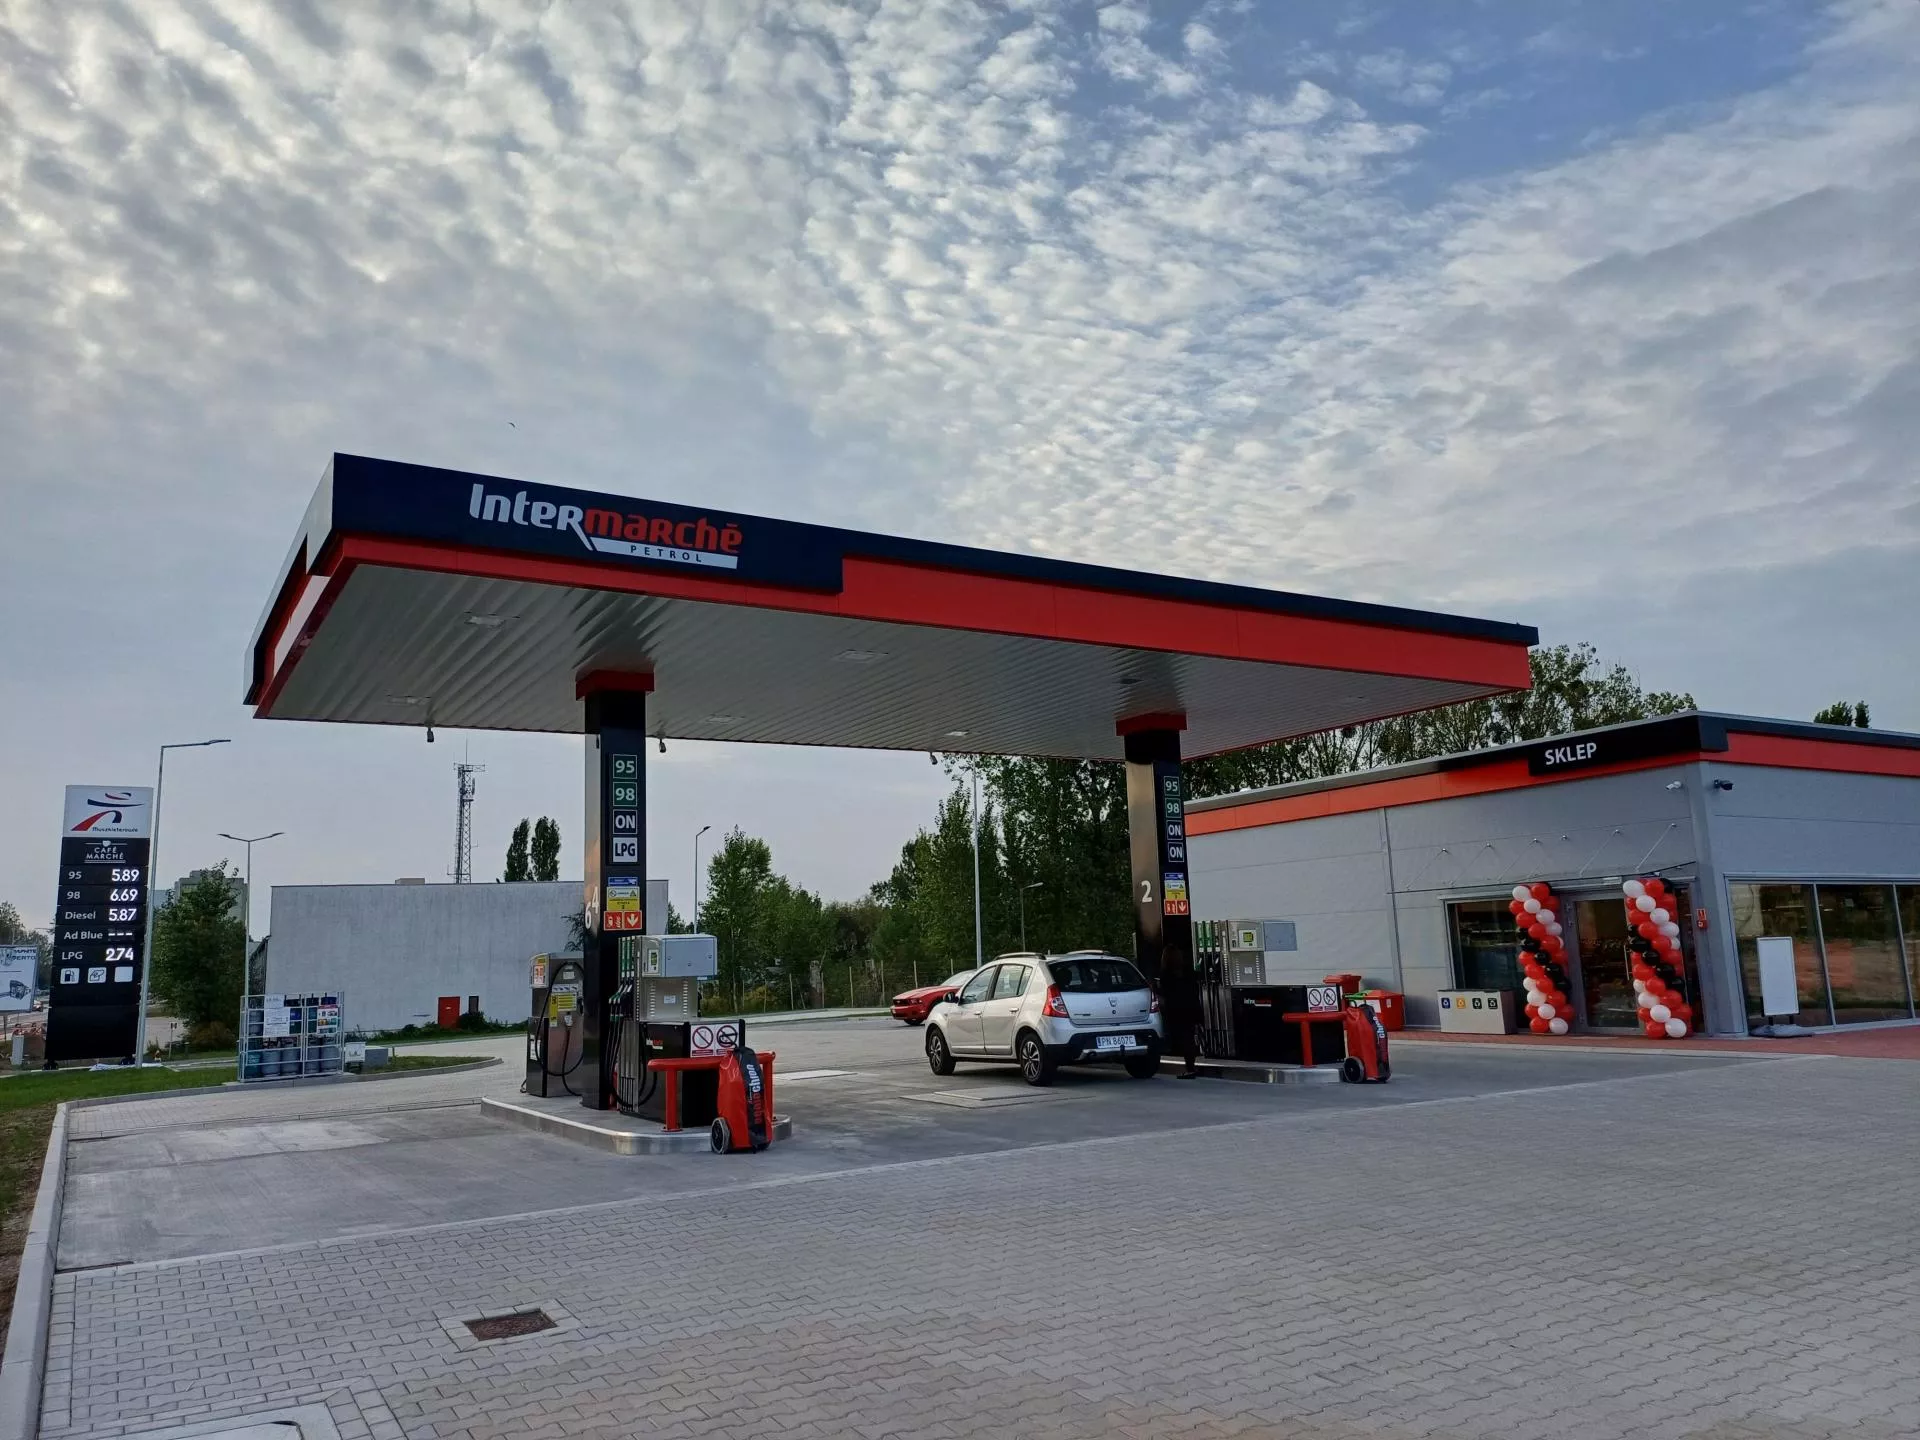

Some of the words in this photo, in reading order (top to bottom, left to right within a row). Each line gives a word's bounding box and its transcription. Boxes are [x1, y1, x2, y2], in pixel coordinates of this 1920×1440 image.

[631, 545, 702, 563] PETROL
[1545, 742, 1597, 765] SKLEP
[615, 760, 635, 774] 95
[1165, 781, 1178, 792] 95
[615, 788, 635, 801] 98
[1167, 803, 1180, 813] 98
[615, 815, 636, 829] ON
[1168, 825, 1181, 836] ON
[615, 843, 636, 857] LPG
[1169, 847, 1183, 858] ON
[68, 871, 82, 879] 95
[111, 869, 140, 881] 5.89
[66, 891, 81, 899] 98
[110, 889, 138, 901] 6.69
[1141, 880, 1153, 903] 2
[591, 886, 599, 914] 4
[65, 911, 96, 919] Diesel
[108, 909, 137, 921] 5.87
[585, 901, 592, 930] 6
[63, 931, 78, 939] Ad
[80, 931, 103, 939] Blue
[61, 952, 83, 960] LPG
